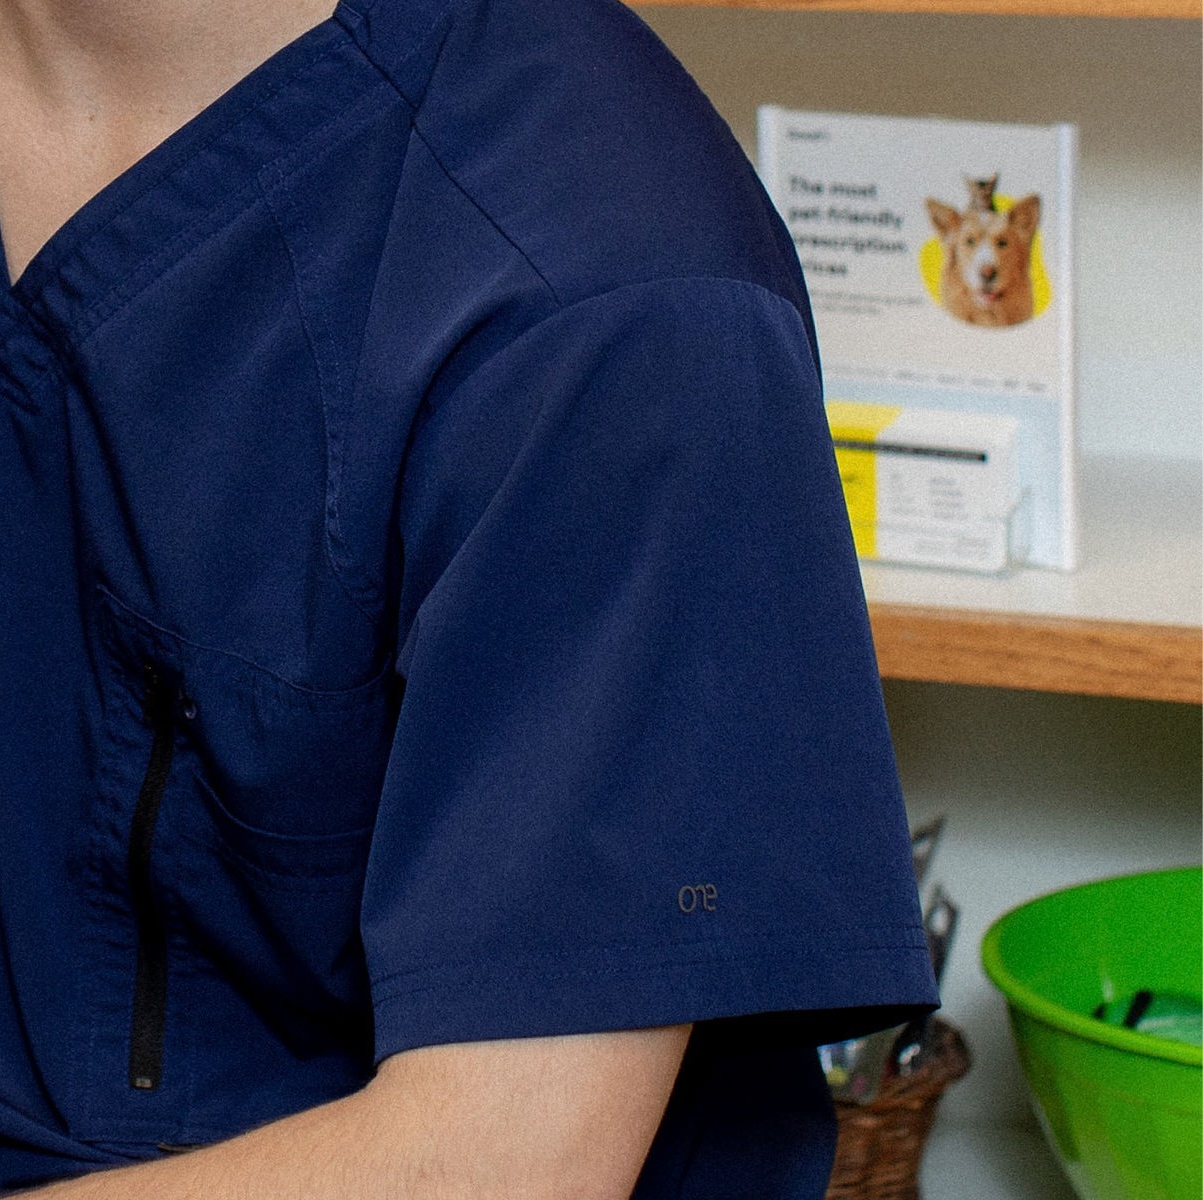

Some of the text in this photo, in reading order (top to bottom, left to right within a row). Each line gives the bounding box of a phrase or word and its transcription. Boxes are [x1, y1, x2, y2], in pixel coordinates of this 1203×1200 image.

[789, 175, 877, 199] The most
[794, 233, 908, 254] rescription
